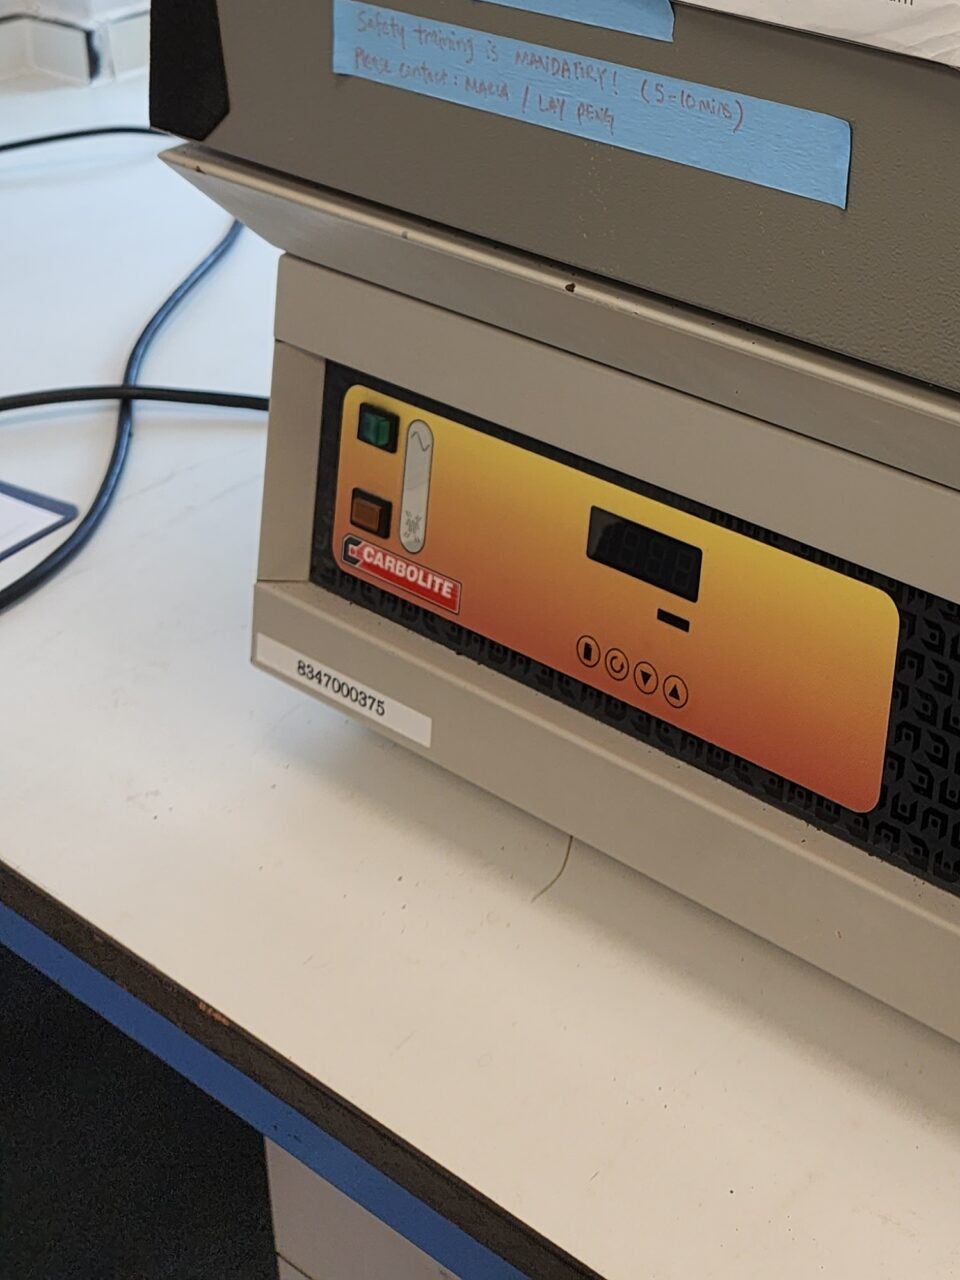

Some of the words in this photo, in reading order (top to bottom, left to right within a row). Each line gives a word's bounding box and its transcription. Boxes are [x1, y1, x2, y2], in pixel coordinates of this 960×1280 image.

[357, 10, 406, 49] Safety
[413, 24, 474, 64] training
[486, 40, 497, 62] is
[362, 548, 454, 600] CARBOLITE
[297, 660, 386, 716] 8347000375
